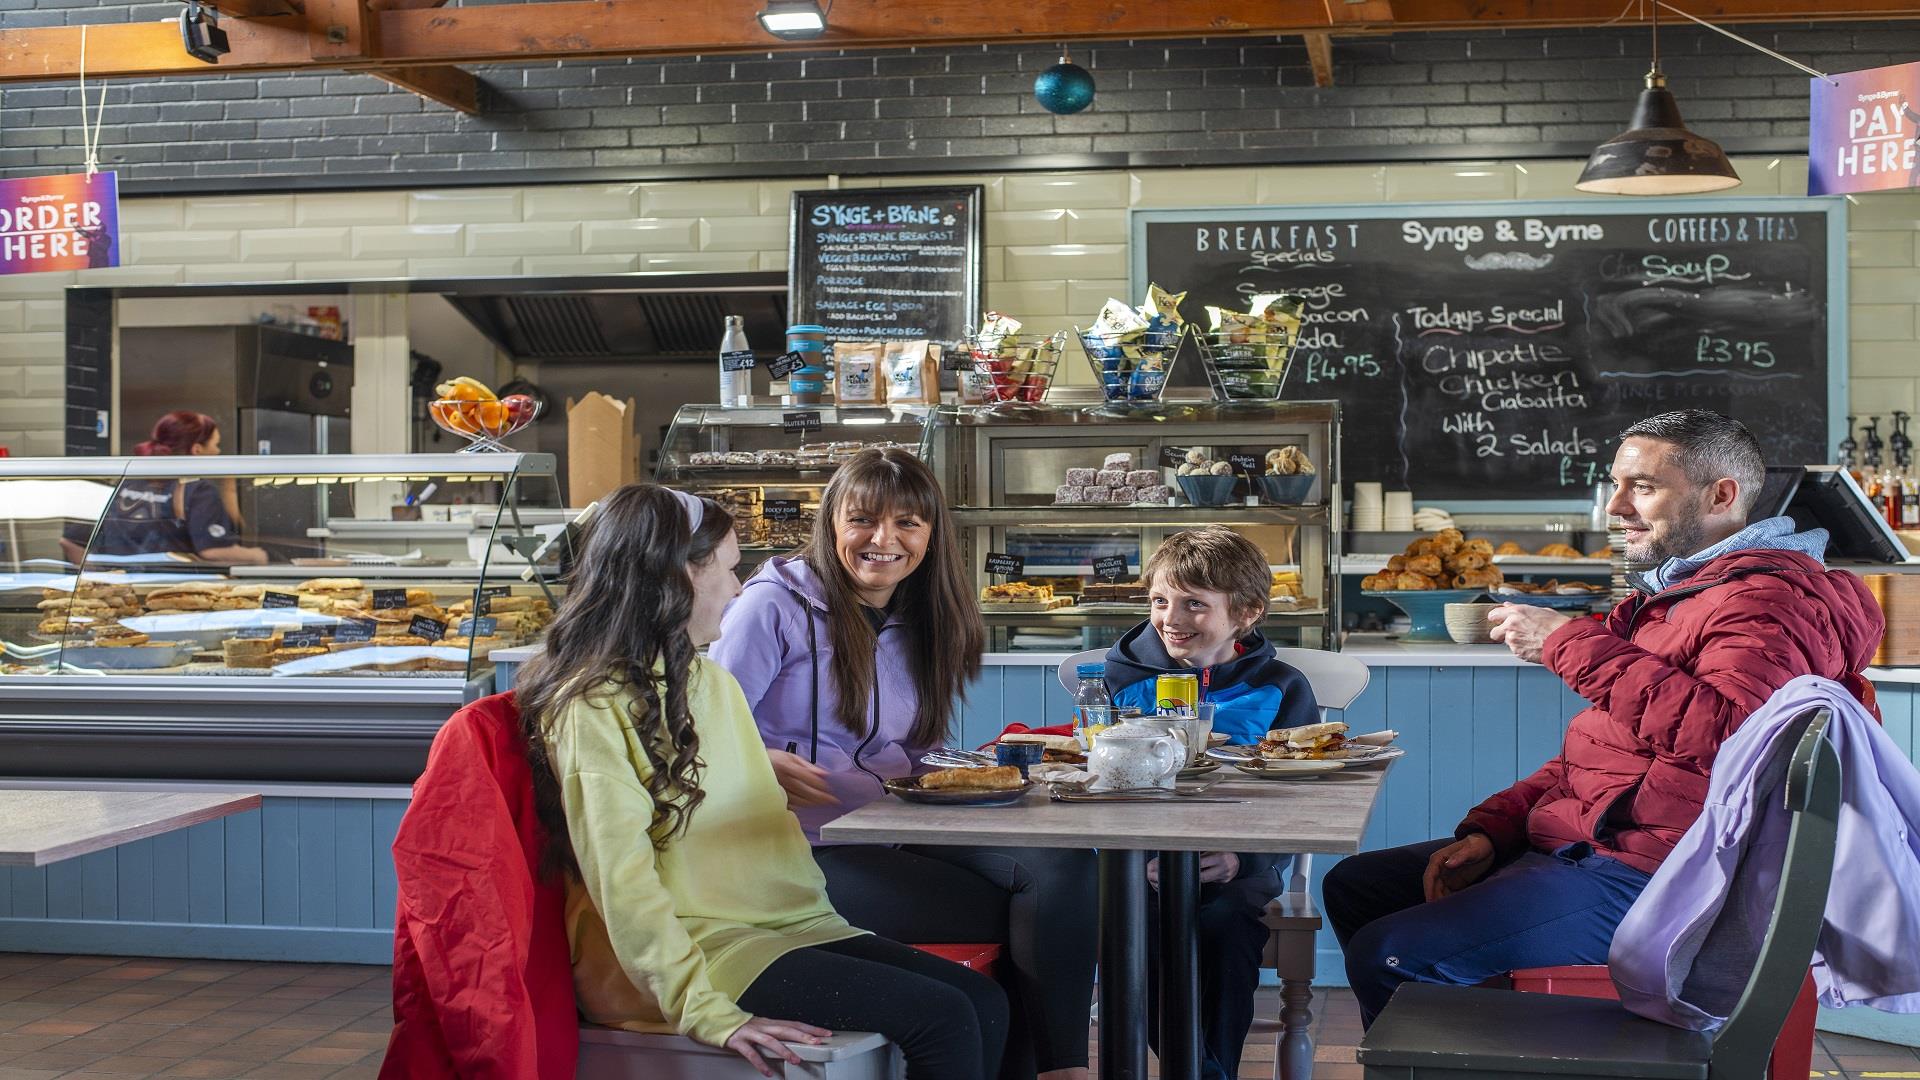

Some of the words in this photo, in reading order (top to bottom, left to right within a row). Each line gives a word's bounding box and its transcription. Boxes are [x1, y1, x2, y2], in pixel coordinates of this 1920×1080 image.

[1849, 102, 1909, 139] PAY
[1838, 138, 1916, 177] HERE
[0, 201, 101, 232] ORDER
[811, 205, 871, 226] SYNGE
[873, 210, 886, 221] +
[887, 205, 940, 224] BYRNE
[899, 231, 955, 242] BREAKFAST
[1197, 224, 1359, 251] BREAKFAST
[1402, 220, 1484, 251] Synge
[1495, 220, 1518, 241] &
[1524, 219, 1604, 248] Byrne
[1648, 218, 1731, 243] COFFEES
[1736, 218, 1749, 241] &
[1755, 217, 1799, 241] TEAS
[4, 232, 89, 261] HERE
[816, 275, 865, 286] PORRIDGE
[816, 301, 859, 310] SAUSAGE
[865, 301, 887, 311] EGG
[892, 302, 923, 310] SODA
[1406, 302, 1484, 331] Todays
[1487, 299, 1563, 326] Special
[864, 326, 904, 335] POACHED
[905, 327, 925, 335] EGG
[740, 359, 754, 367] £12
[1306, 352, 1380, 383] £4.95
[1422, 343, 1572, 376] Chipotle
[1439, 370, 1579, 396] Chicken
[1481, 386, 1588, 412] Ciabatta
[1476, 434, 1504, 457] 2
[1510, 427, 1598, 456] Salads
